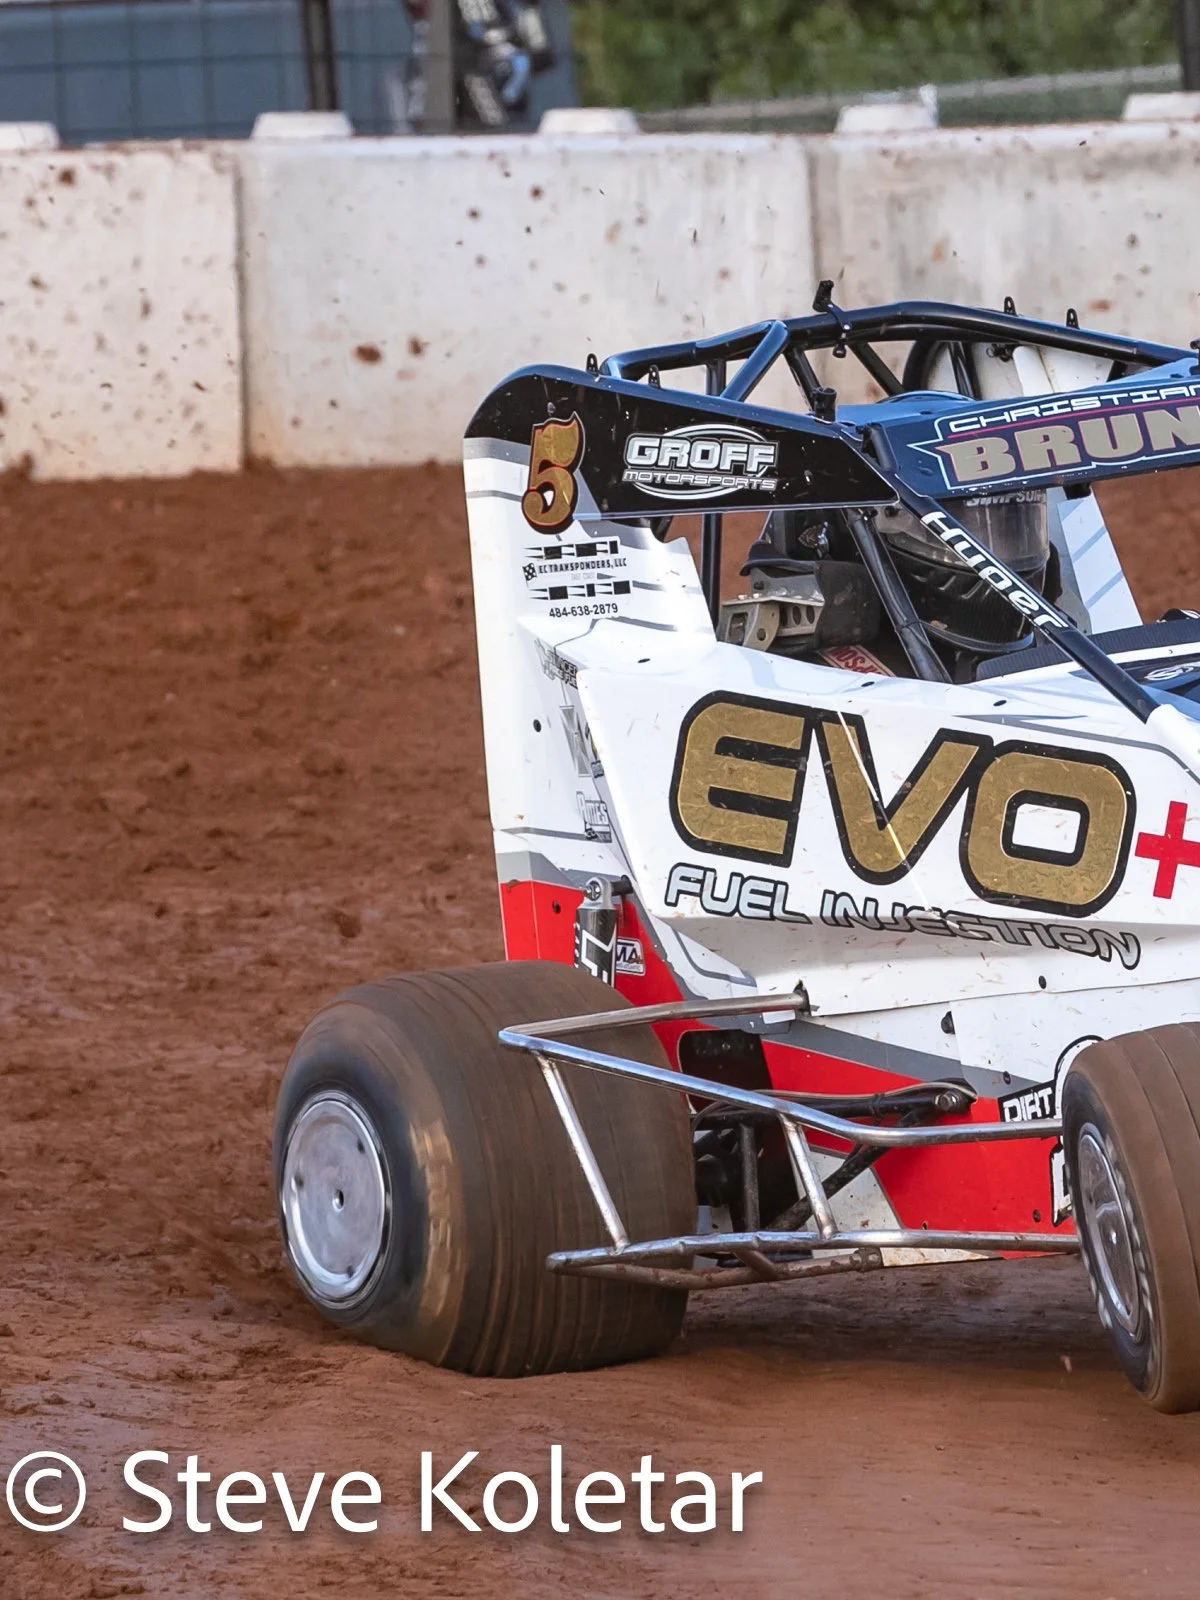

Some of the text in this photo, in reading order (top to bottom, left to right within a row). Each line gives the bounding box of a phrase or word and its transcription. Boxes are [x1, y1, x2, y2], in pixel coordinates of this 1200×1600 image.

[522, 411, 585, 534] 5
[624, 434, 778, 474] GROFF
[622, 469, 778, 491] MOTORSPORTS
[614, 558, 627, 567] LLC
[549, 603, 618, 618] 484-638-2879
[668, 690, 1137, 918] EVO
[665, 862, 1142, 970] FUEL INJECTION
[1002, 1087, 1054, 1123] DIRT
